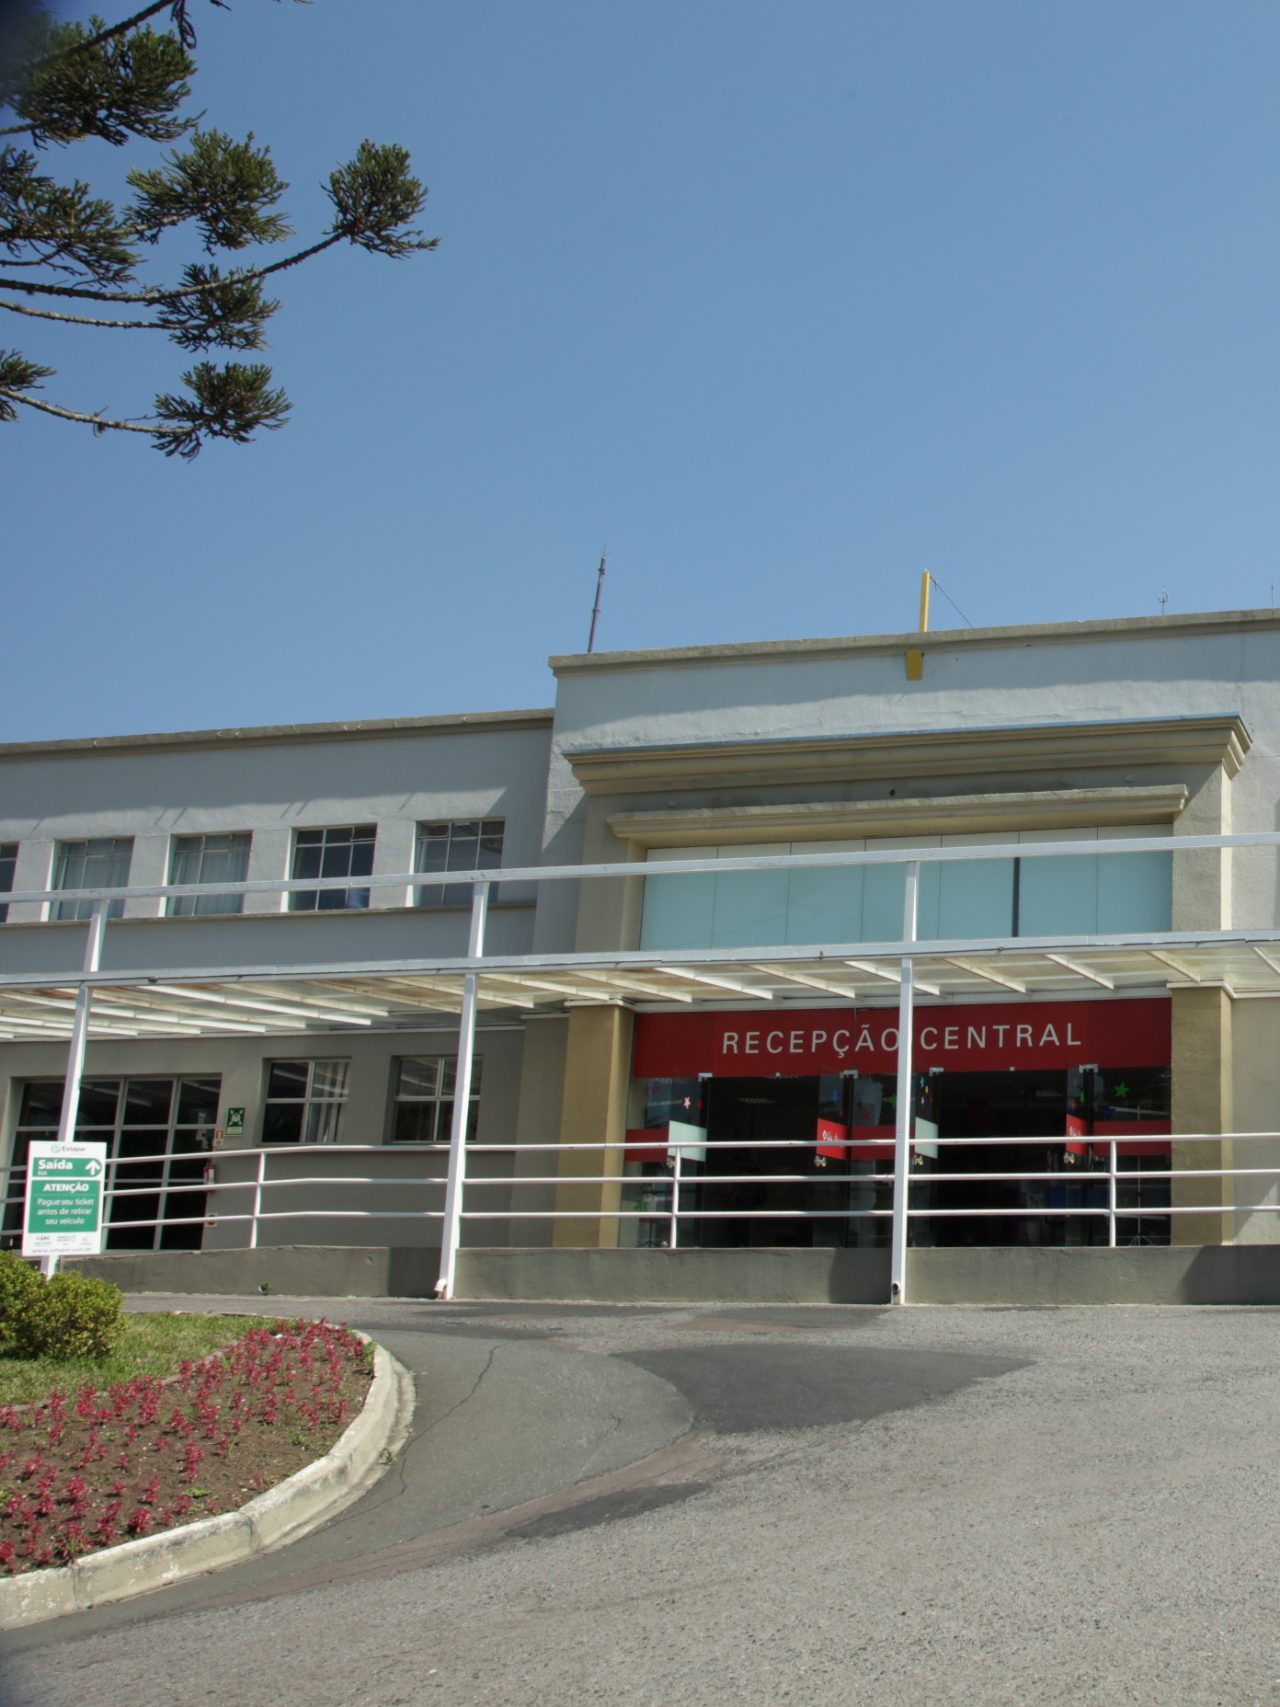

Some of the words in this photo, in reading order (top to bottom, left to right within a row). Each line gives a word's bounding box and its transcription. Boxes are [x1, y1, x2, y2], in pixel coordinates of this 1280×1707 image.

[722, 1024, 900, 1058] RECEPÇÃO
[920, 1022, 1082, 1050] CENTRAL
[37, 1159, 73, 1170] Saída
[43, 1182, 89, 1193] ATENÇÃO
[37, 1198, 60, 1207] Pague
[75, 1198, 94, 1206] ticket
[37, 1208, 58, 1216] antes
[70, 1207, 92, 1215] retirar
[59, 1217, 85, 1225] veículo
